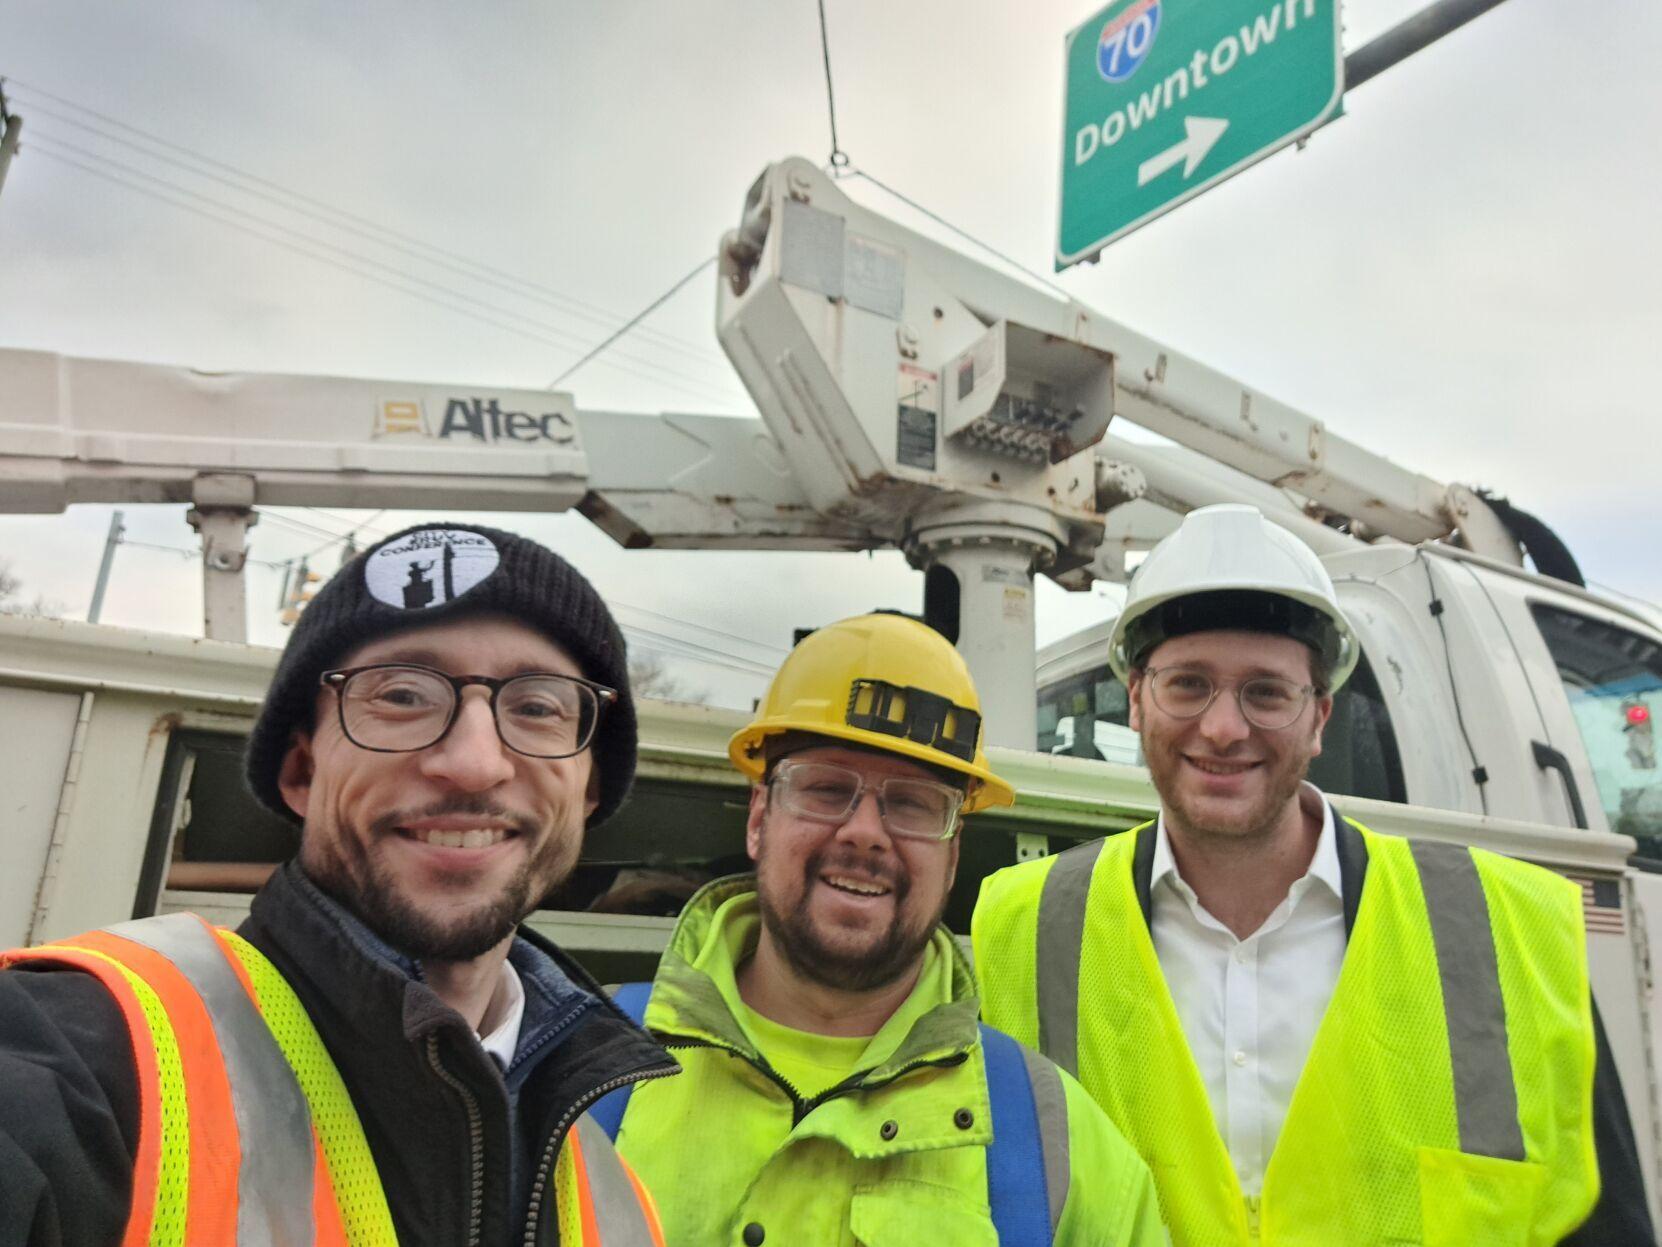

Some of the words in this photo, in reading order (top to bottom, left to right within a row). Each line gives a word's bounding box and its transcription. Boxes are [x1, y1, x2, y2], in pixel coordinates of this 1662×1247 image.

[1103, 13, 1152, 74] 70
[1074, 0, 1315, 166] Downtown
[438, 398, 574, 443] Altec
[380, 539, 486, 557] CONFERNCE
